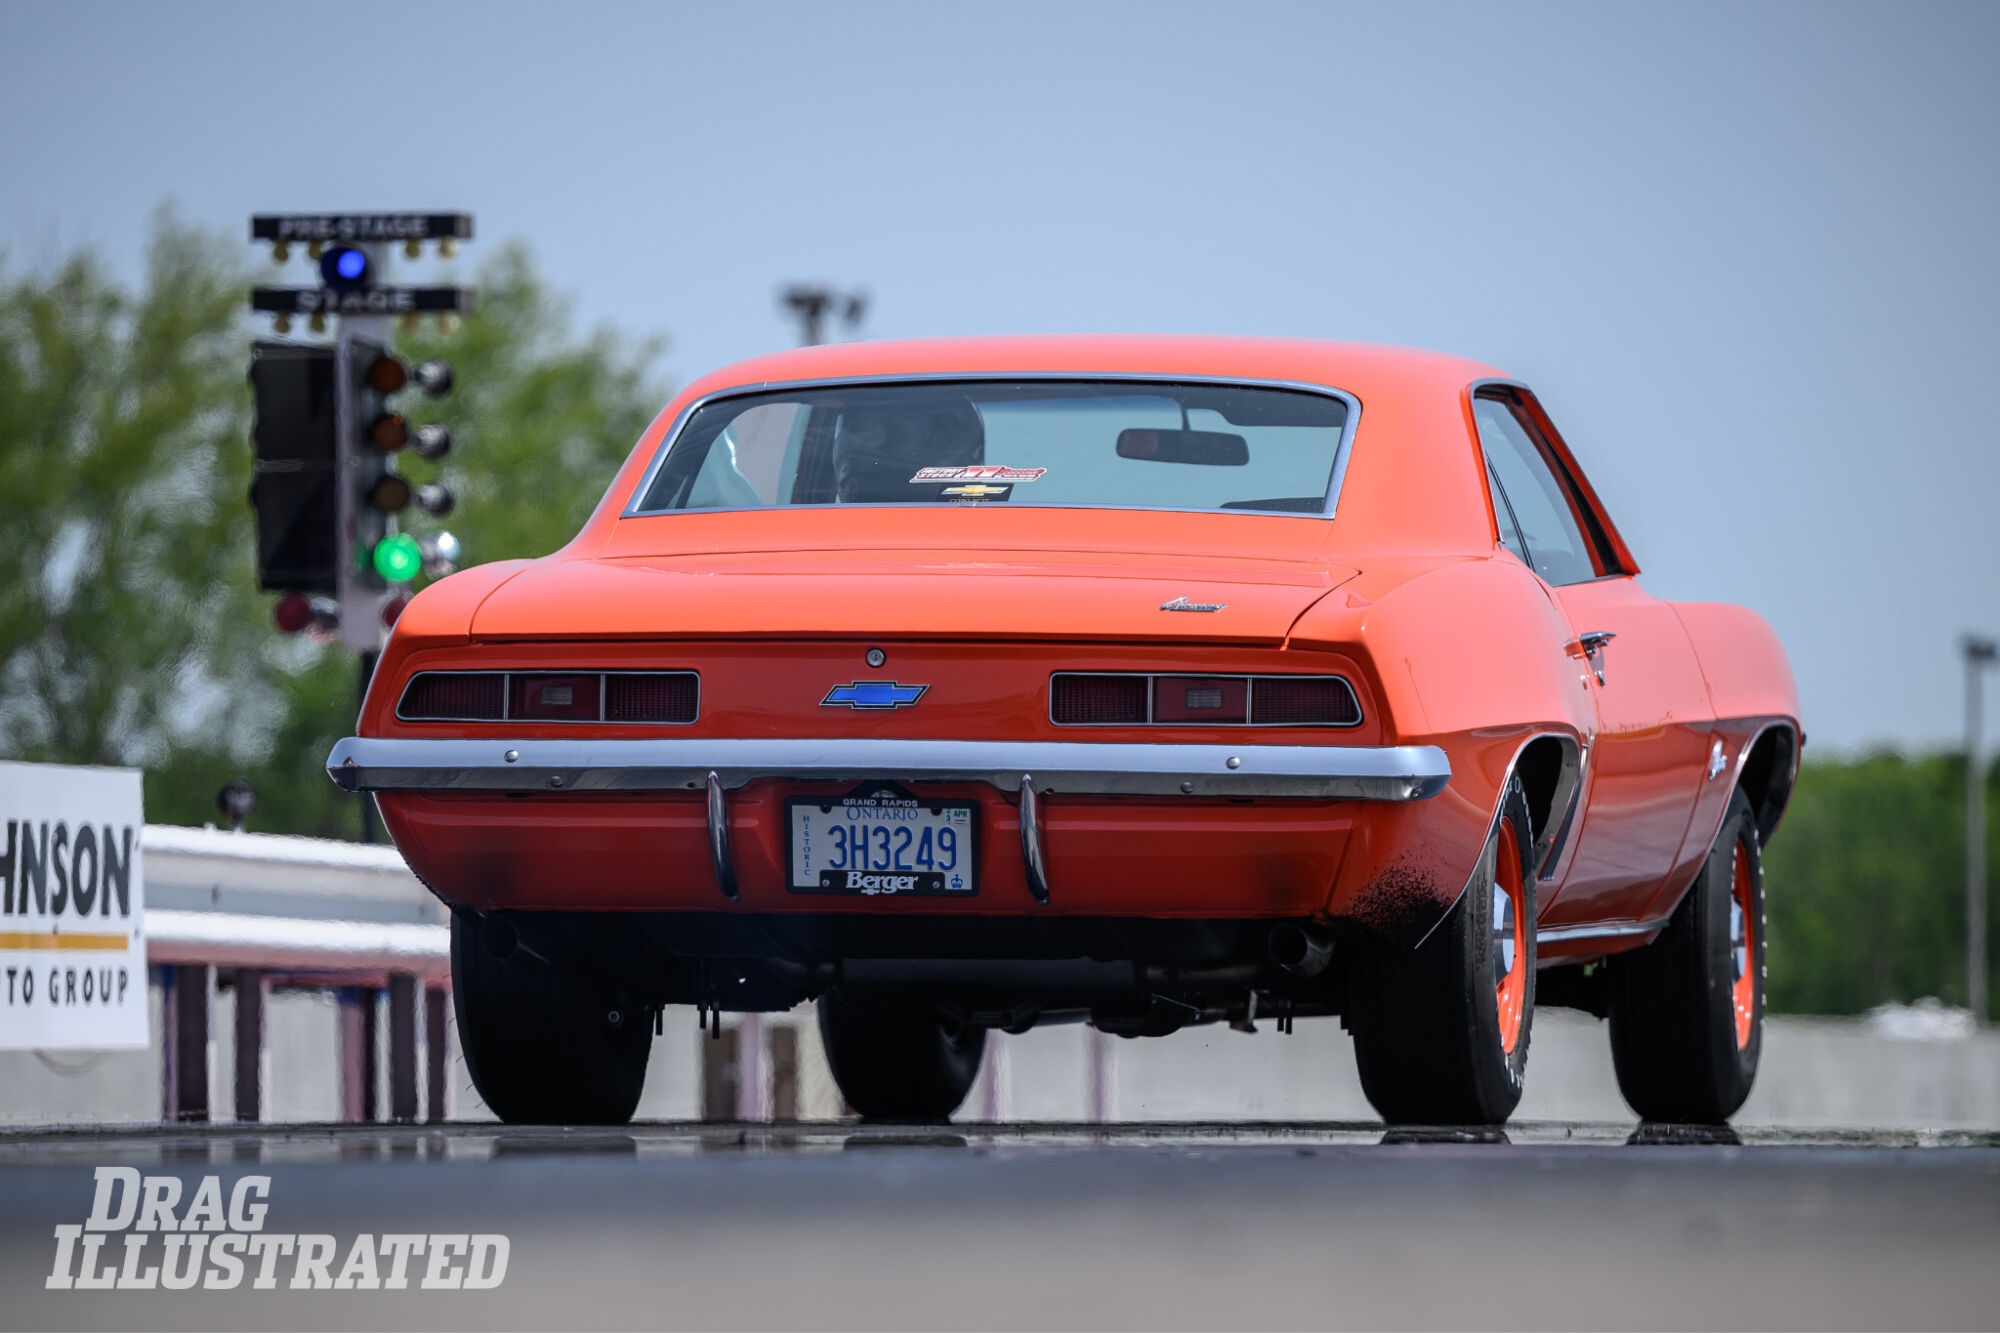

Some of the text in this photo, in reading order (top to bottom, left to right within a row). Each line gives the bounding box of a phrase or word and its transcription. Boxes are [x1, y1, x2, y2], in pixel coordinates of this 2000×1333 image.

[296, 287, 415, 311] STAGE
[843, 798, 918, 808] GRAND RAPIDS
[846, 806, 919, 821] ONTARIO
[802, 815, 811, 876] HISTORIC
[828, 824, 957, 871] 3H3249
[845, 871, 919, 894] Berger
[49, 967, 129, 1006] GROUP
